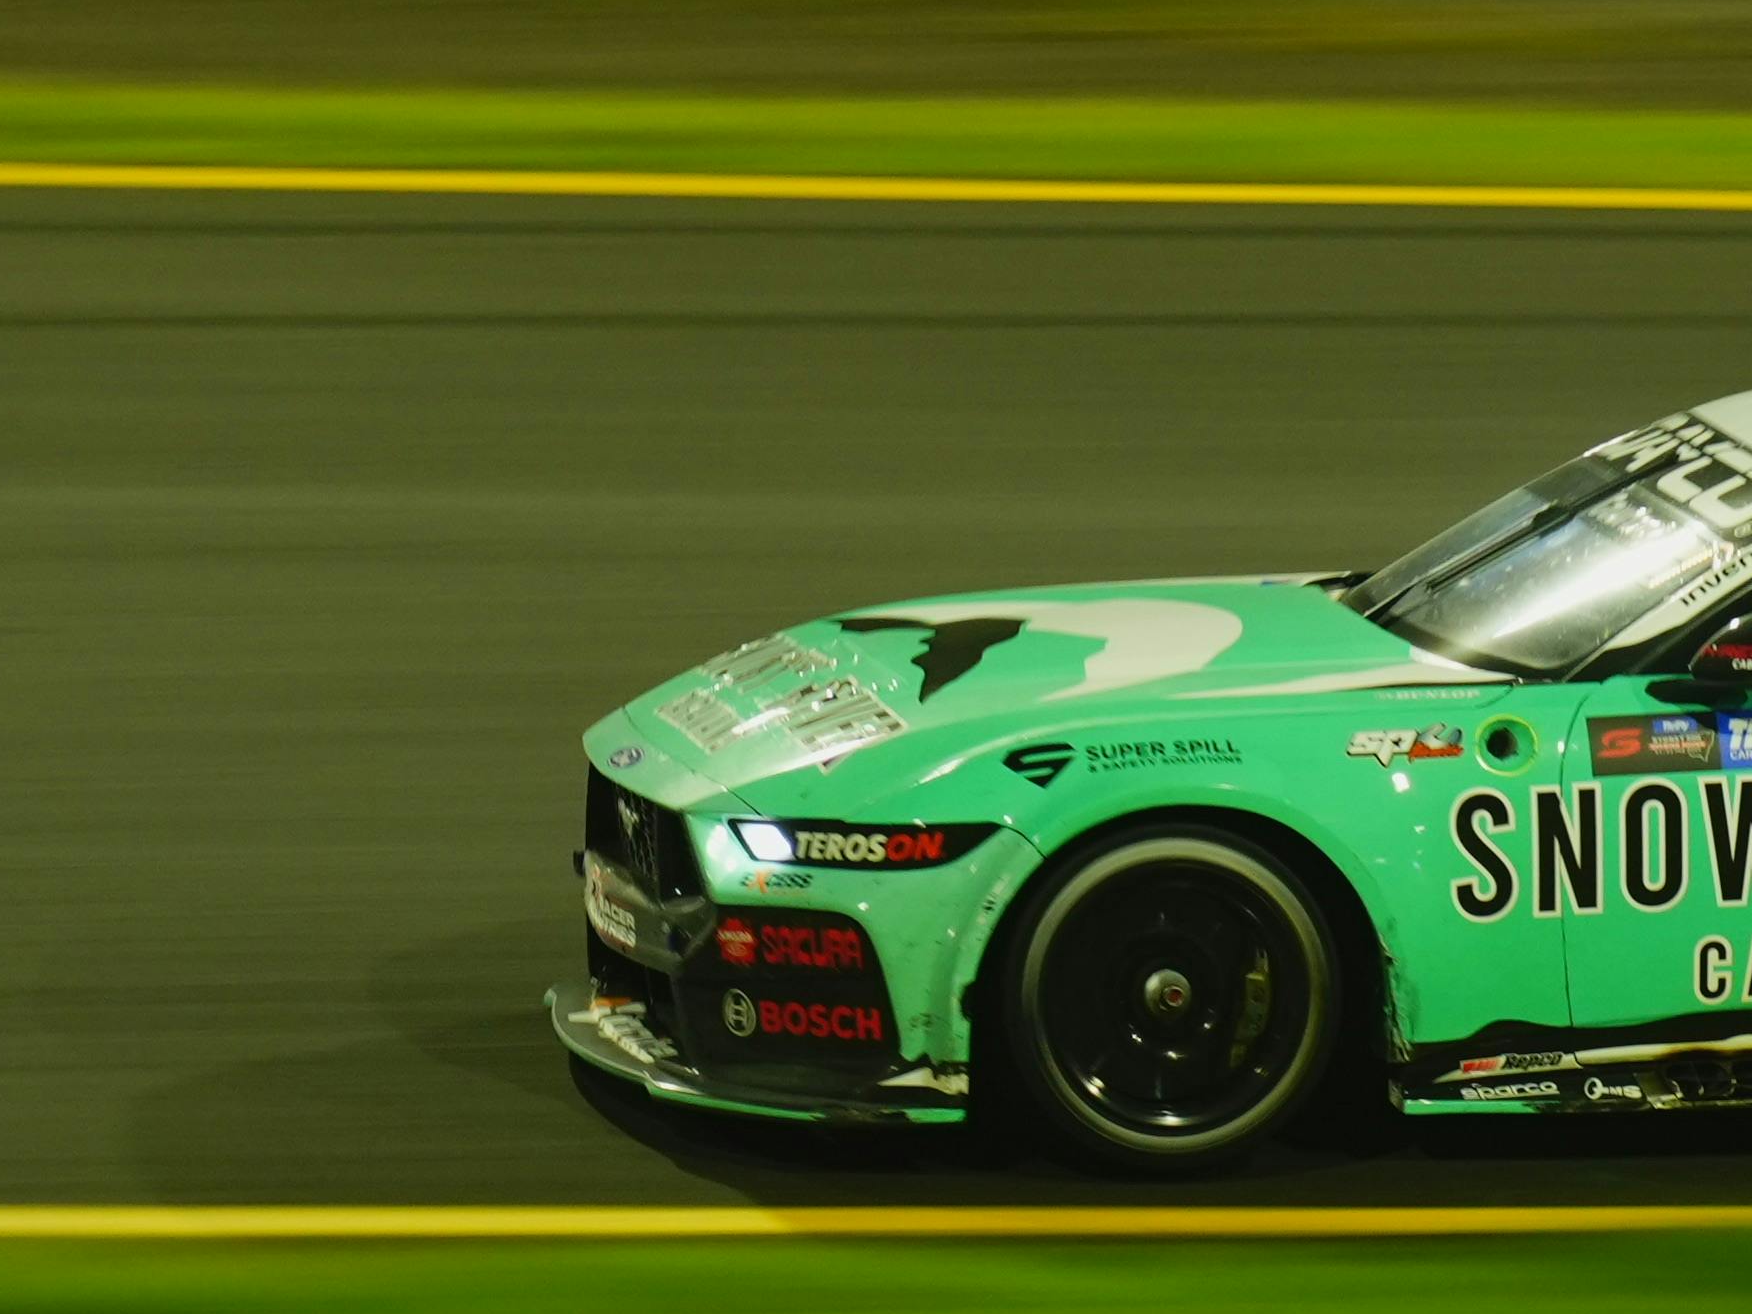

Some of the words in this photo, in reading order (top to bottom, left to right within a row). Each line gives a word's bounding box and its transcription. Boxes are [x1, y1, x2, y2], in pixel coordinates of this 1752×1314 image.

[1084, 741, 1166, 763] SUPER
[1171, 738, 1242, 757] SPILL
[794, 830, 944, 863] TEROSON
[758, 999, 883, 1041] BOSCH
[1460, 1080, 1560, 1101] sparco
